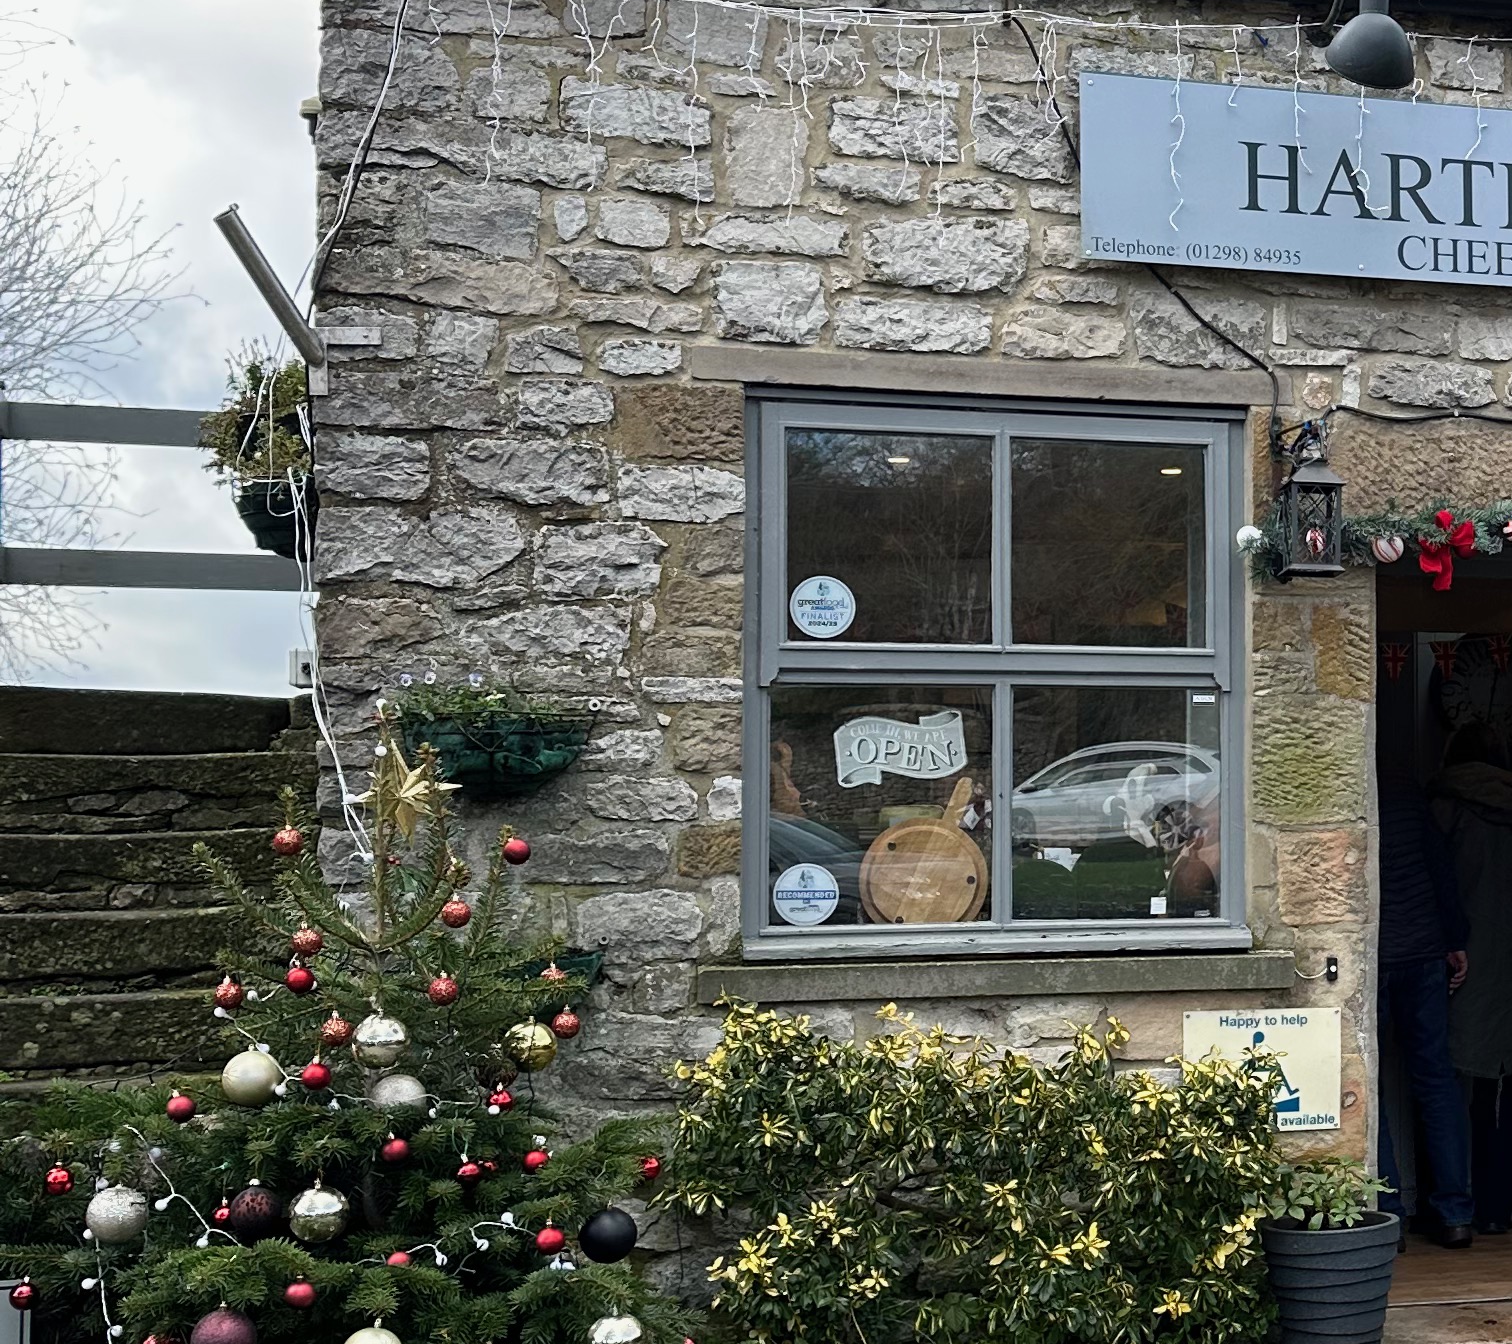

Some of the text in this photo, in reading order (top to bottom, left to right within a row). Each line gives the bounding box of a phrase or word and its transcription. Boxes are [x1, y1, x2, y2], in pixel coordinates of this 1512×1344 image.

[1185, 242, 1249, 265] (01298)
[1253, 247, 1302, 266] 84935
[801, 612, 845, 621] FINALIST
[851, 736, 953, 771] OPEN
[1219, 1014, 1308, 1029] Happy to help
[1280, 1113, 1335, 1127] available
